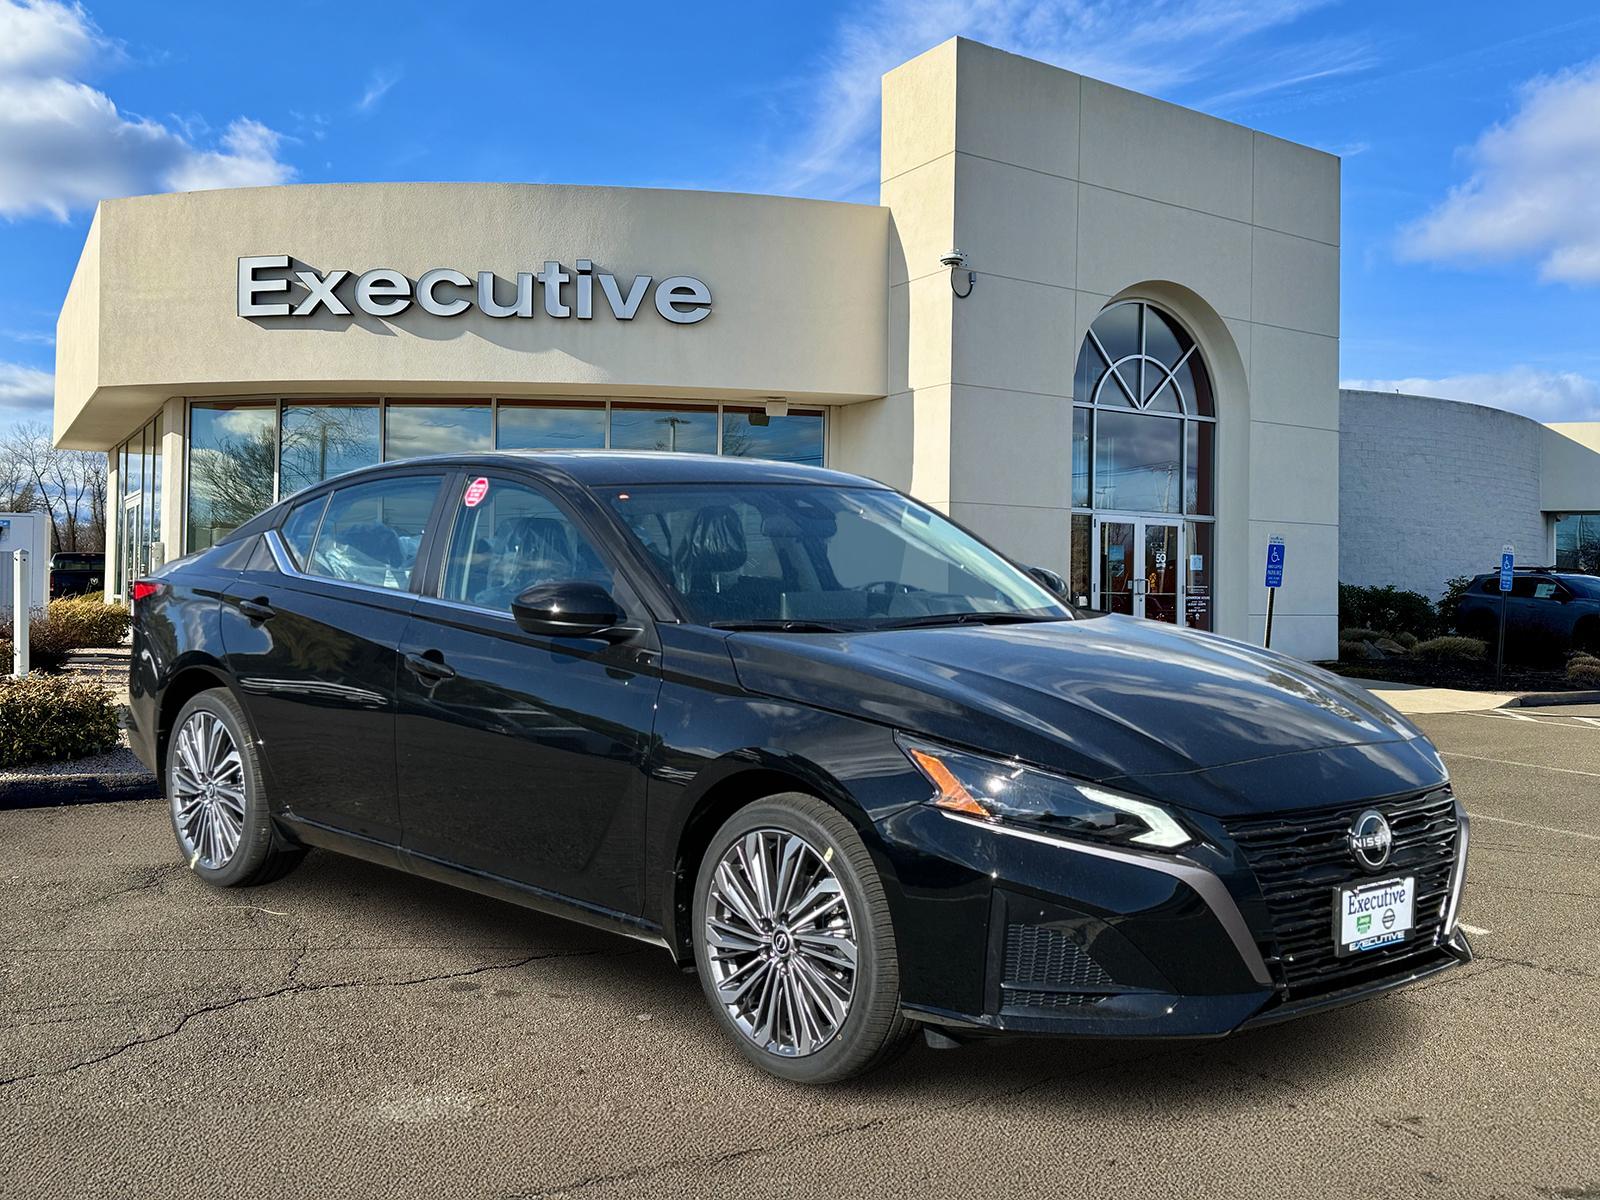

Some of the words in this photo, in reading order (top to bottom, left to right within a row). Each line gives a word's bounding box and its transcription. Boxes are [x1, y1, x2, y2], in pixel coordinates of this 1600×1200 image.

[237, 255, 713, 324] Executive
[1348, 887, 1406, 915] Executive
[1349, 930, 1405, 952] EXECUTIVE
